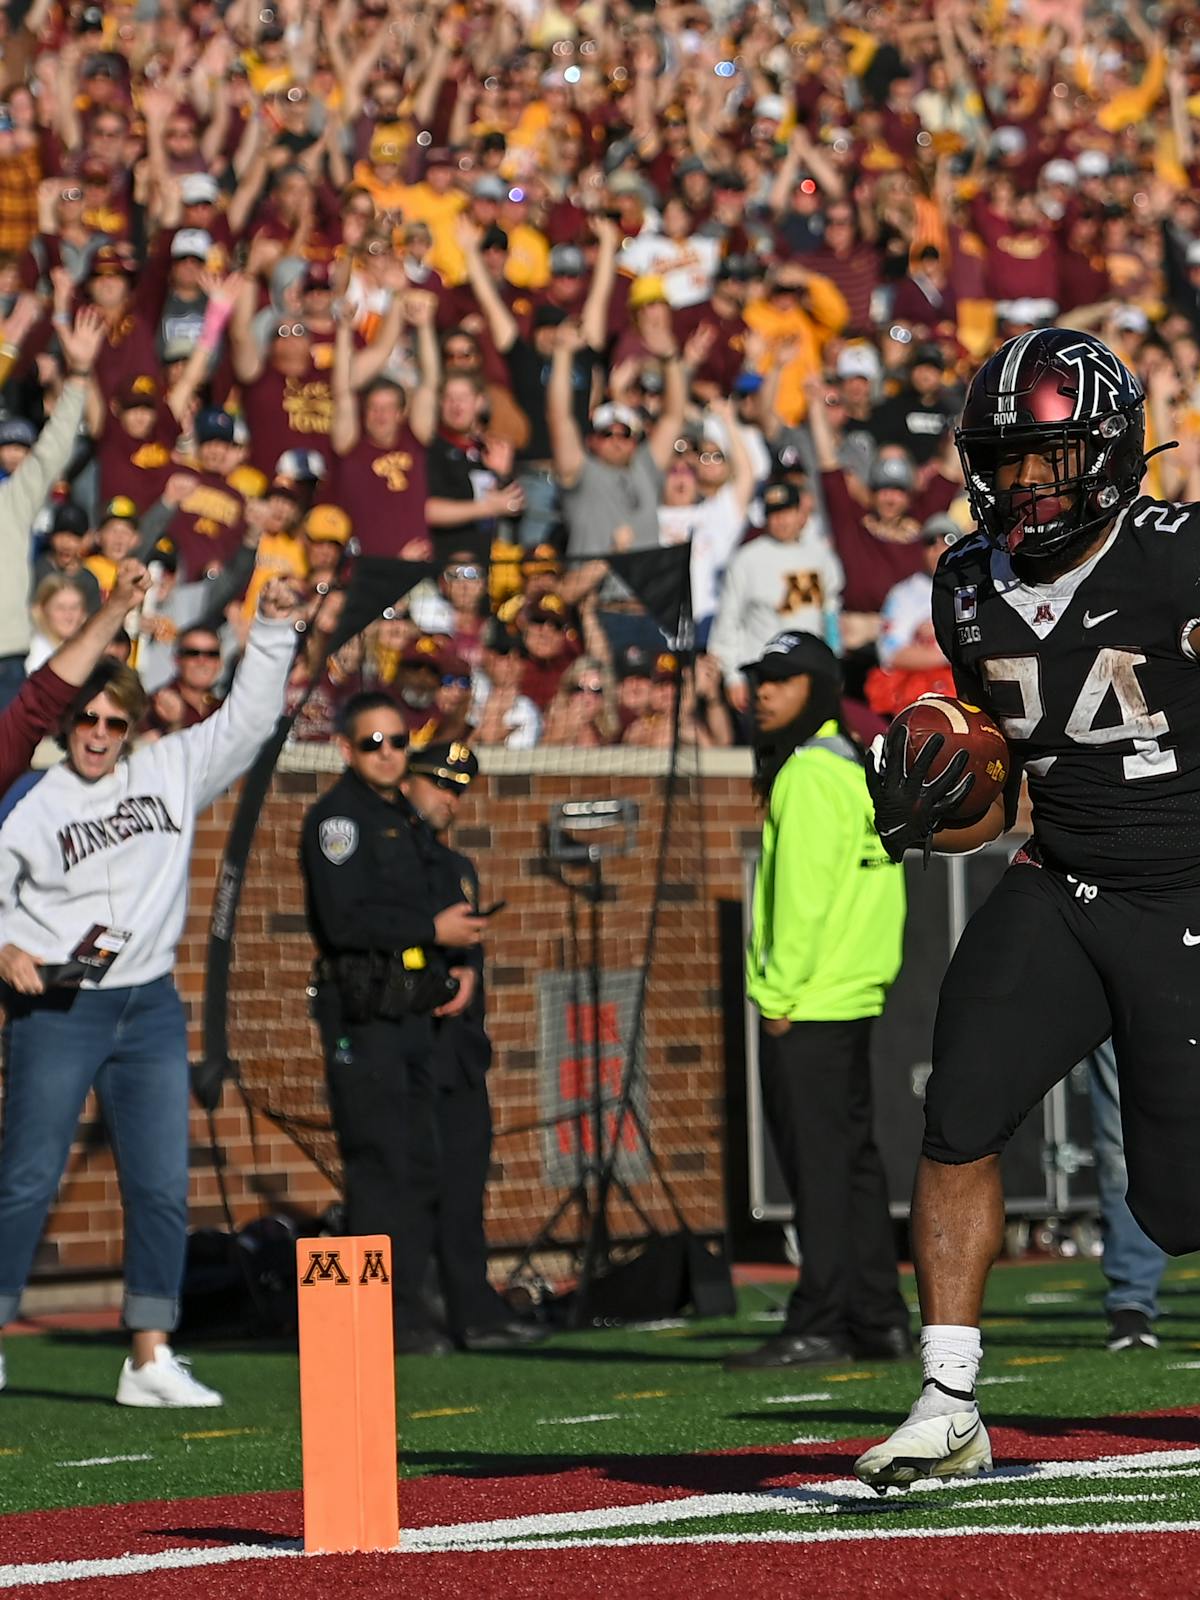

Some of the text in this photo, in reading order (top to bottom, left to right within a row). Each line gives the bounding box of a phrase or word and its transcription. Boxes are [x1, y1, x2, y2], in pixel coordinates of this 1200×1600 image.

[993, 411, 1018, 426] ROW
[984, 647, 1178, 781] 24
[56, 795, 181, 874] MINNESOTA
[300, 1250, 351, 1286] M
[359, 1249, 390, 1286] M
